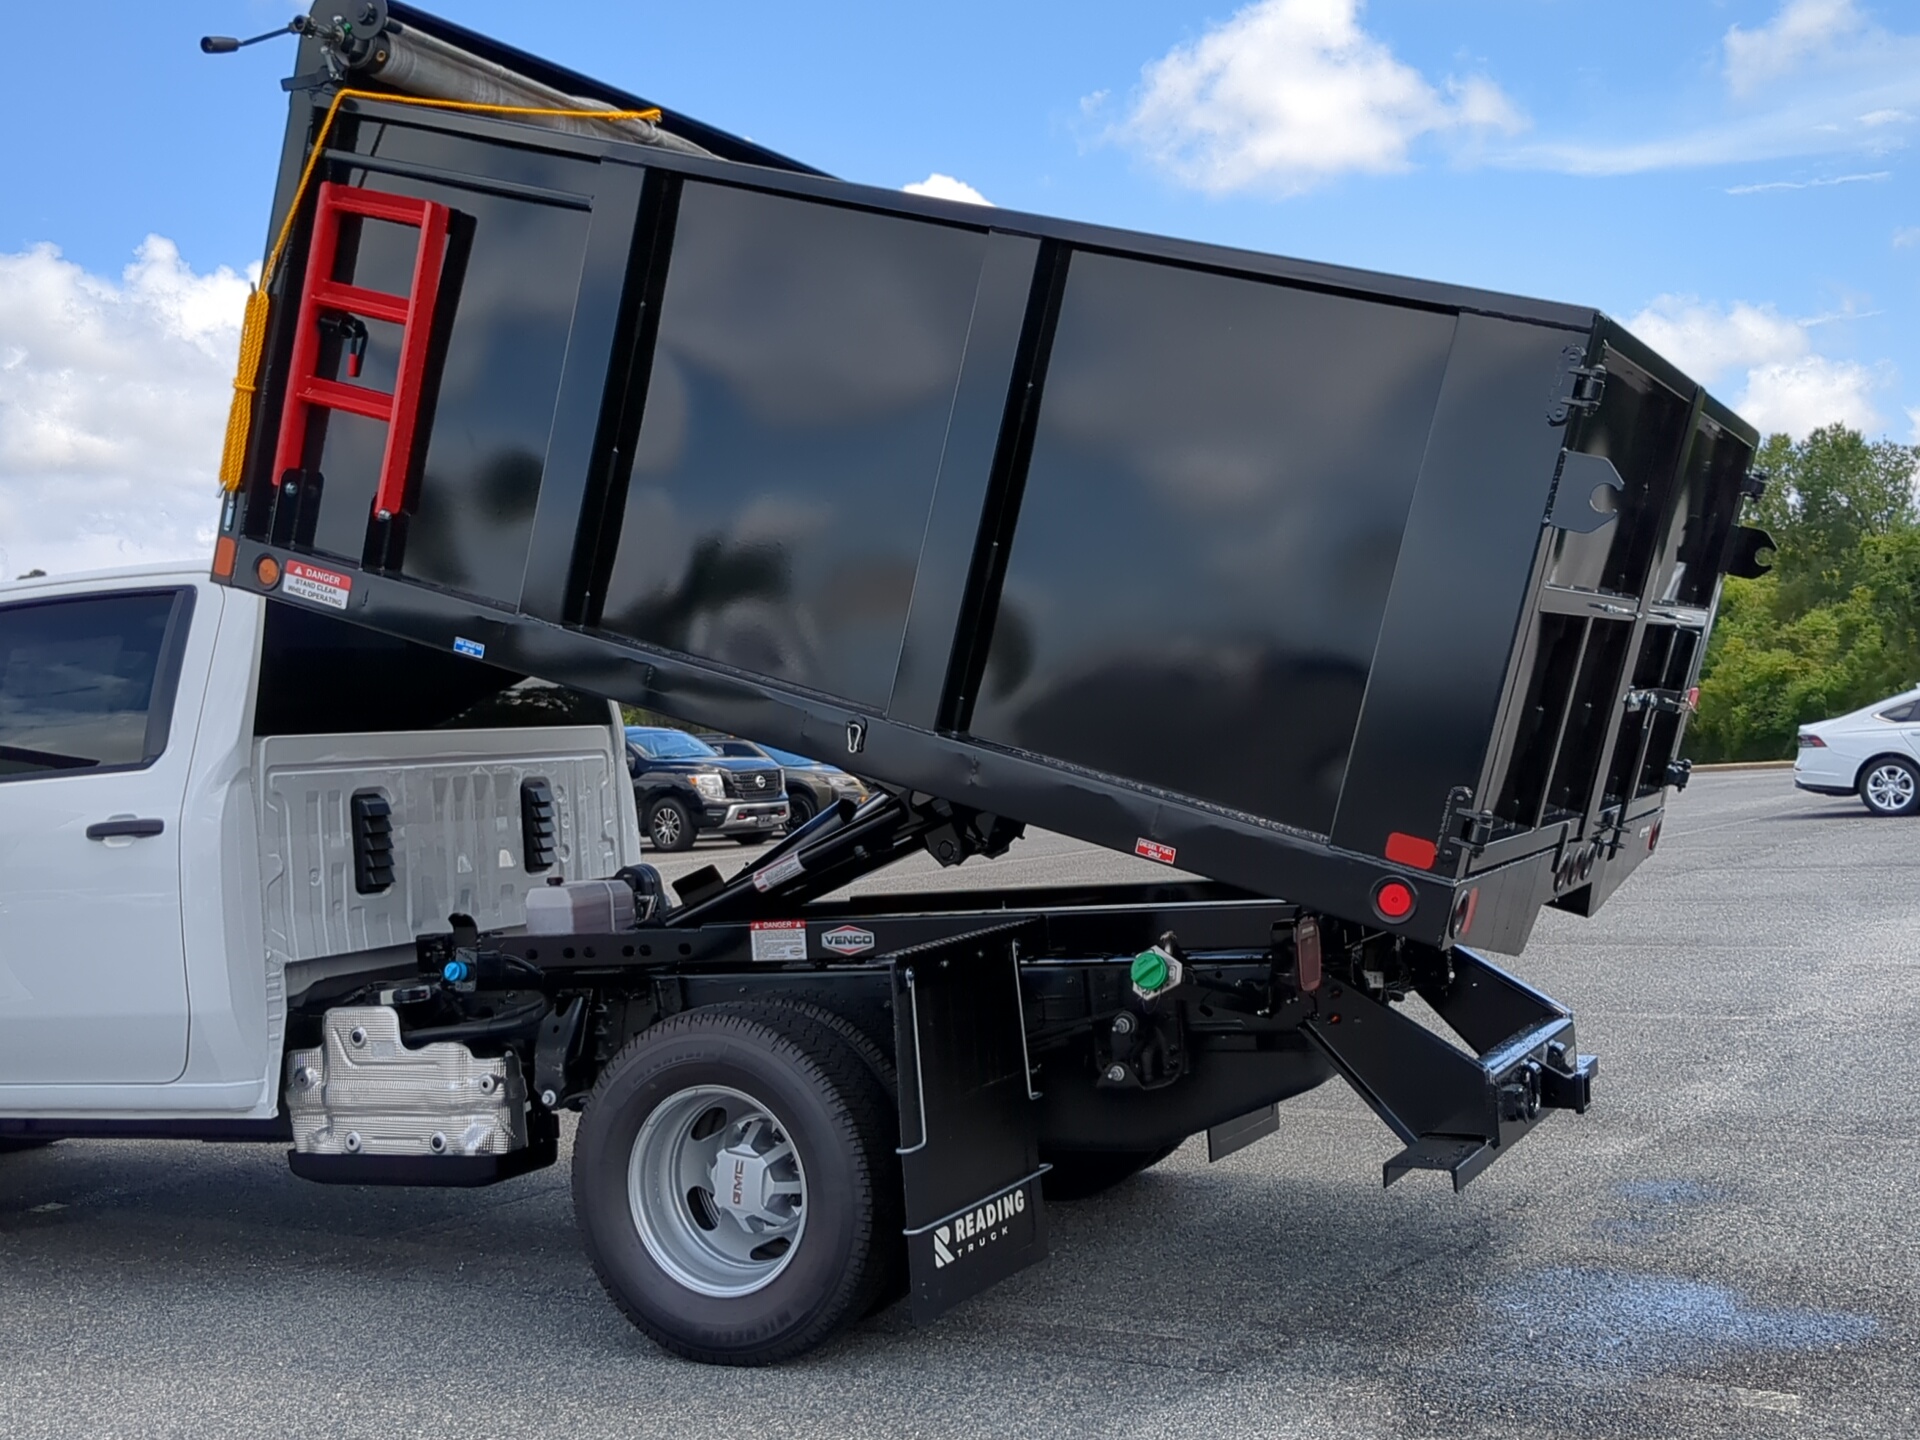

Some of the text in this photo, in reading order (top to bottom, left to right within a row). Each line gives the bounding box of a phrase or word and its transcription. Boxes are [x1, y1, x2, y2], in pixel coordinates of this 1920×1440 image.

[305, 568, 341, 586] DANGER
[295, 578, 337, 595] STAND CLEAR
[287, 585, 343, 607] WHILE OPERATING
[1139, 840, 1173, 857] DIESEL FUEL
[1147, 850, 1162, 859] ONLY
[763, 921, 792, 929] DANGER
[824, 935, 873, 945] VENCO
[733, 1159, 744, 1205] GMC
[955, 1189, 1025, 1243] READING
[957, 1226, 1009, 1257] TRUCK
